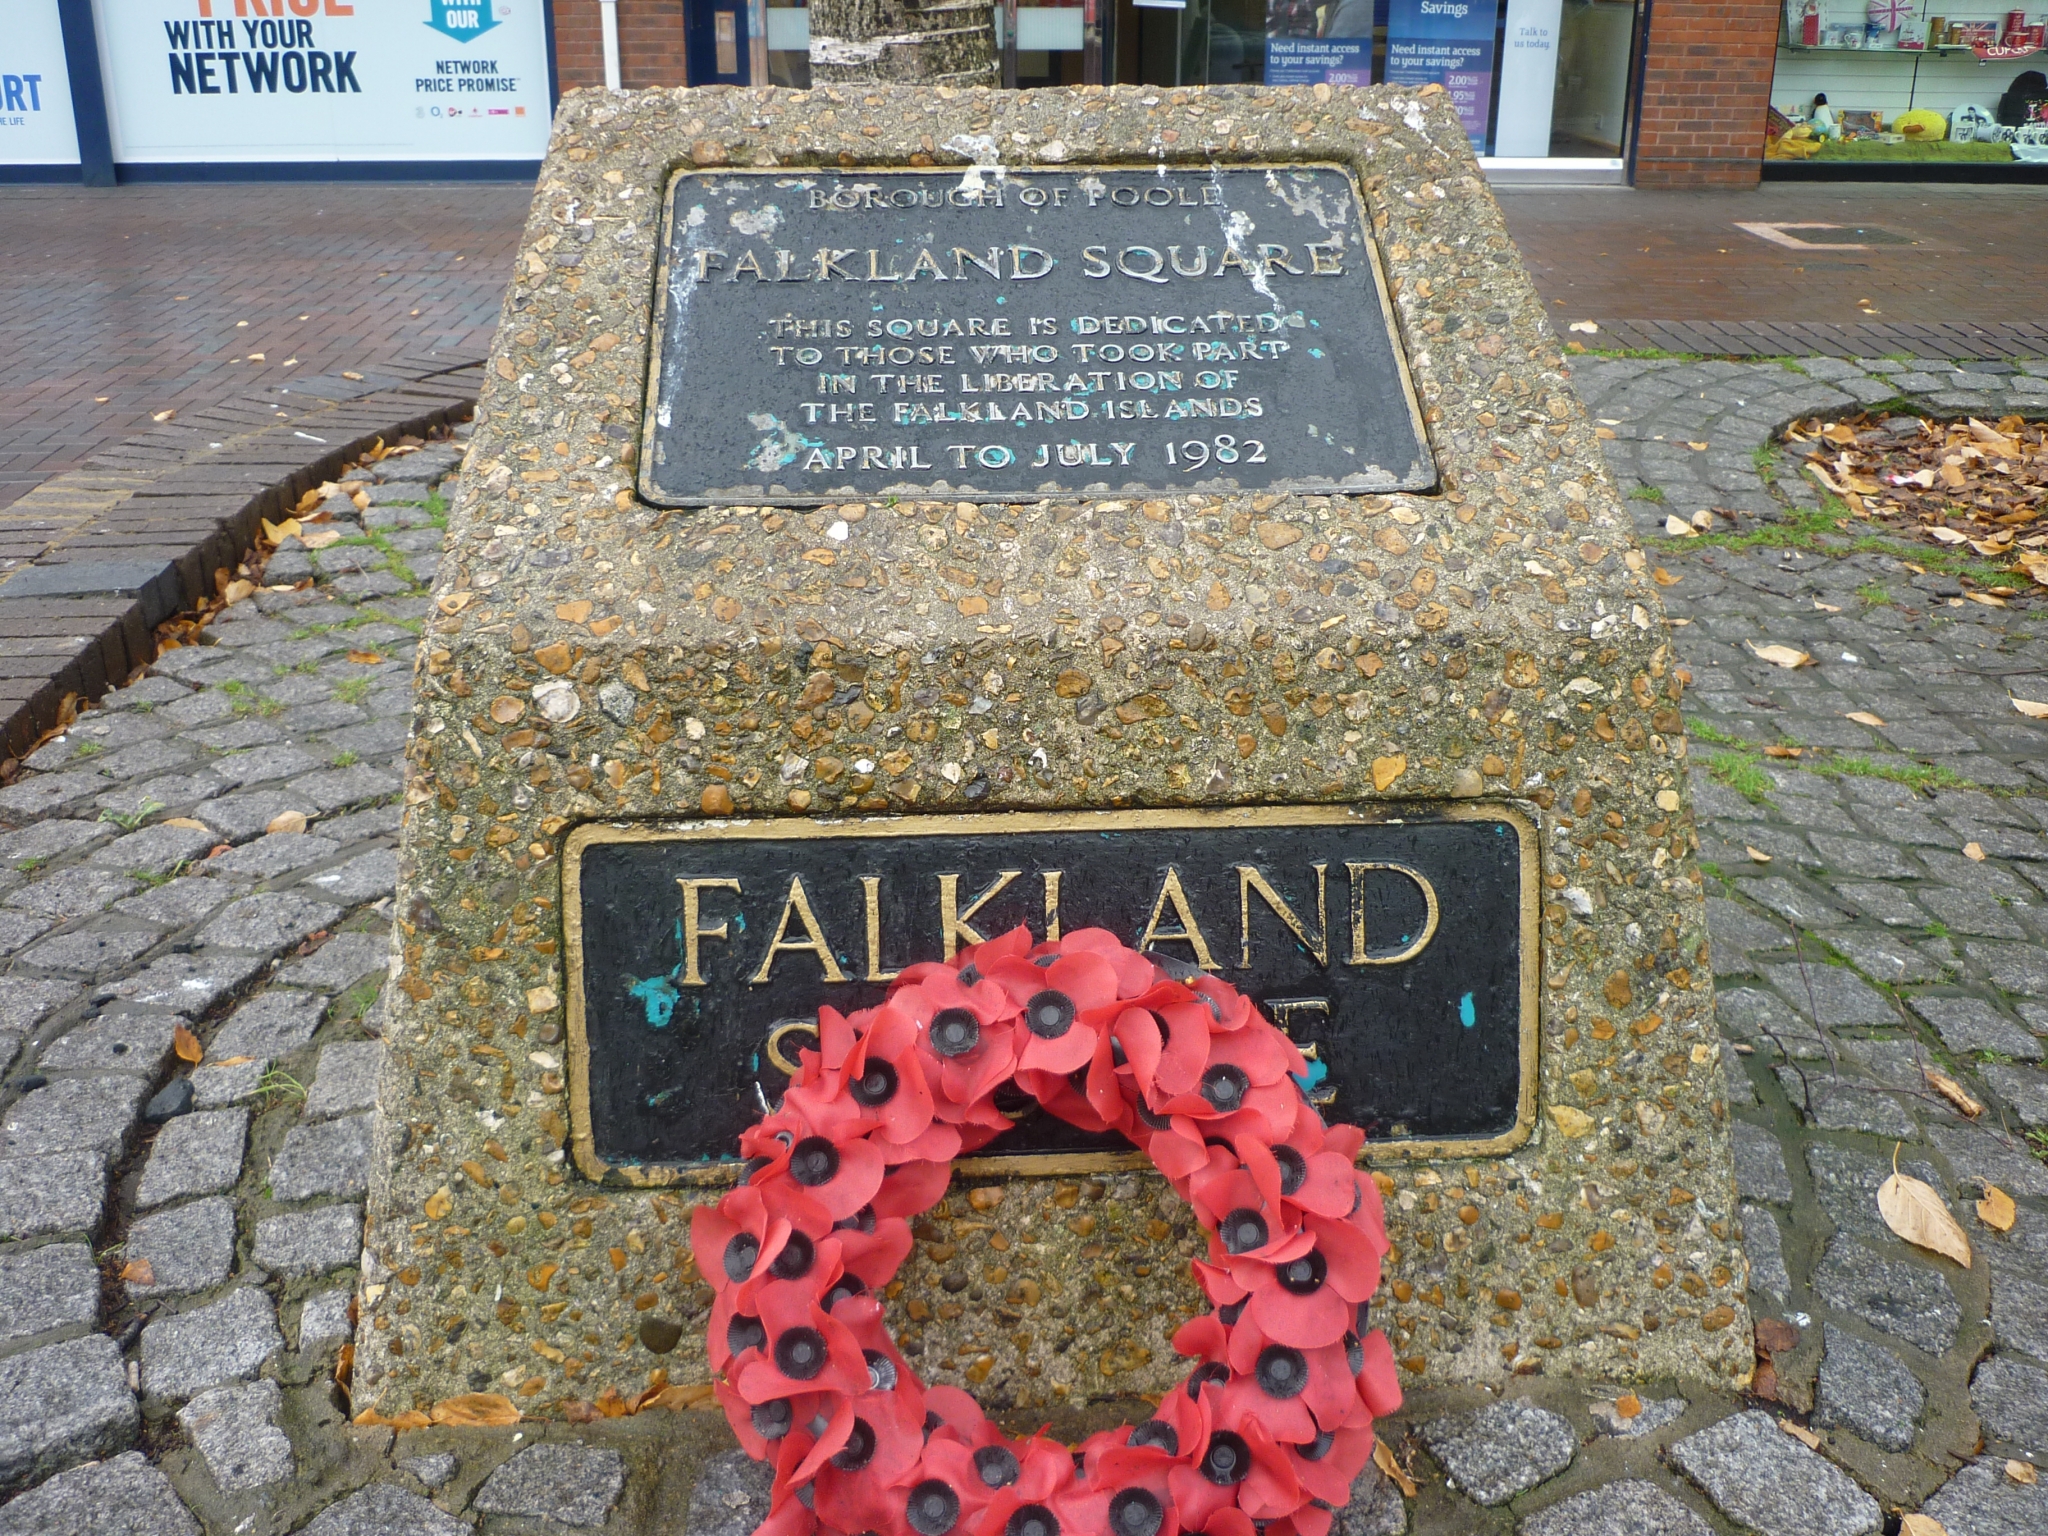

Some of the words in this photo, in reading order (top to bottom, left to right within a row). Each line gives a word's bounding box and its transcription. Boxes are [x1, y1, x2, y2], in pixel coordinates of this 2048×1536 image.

[446, 9, 480, 29] OUR
[1421, 1, 1468, 18] Savings
[164, 20, 236, 50] WITH
[242, 19, 316, 49] YOUR
[1519, 27, 1538, 36] Talk
[1540, 28, 1548, 36] to
[1271, 42, 1296, 54] Need
[1297, 43, 1330, 54] instant
[1331, 45, 1360, 54] access
[1391, 43, 1416, 55] Need
[1417, 45, 1451, 56] instant
[1452, 47, 1481, 57] access
[1514, 40, 1524, 48] us
[436, 60, 499, 74] NETWORK
[1270, 55, 1280, 65] to
[1281, 57, 1304, 67] your
[1305, 55, 1344, 67] savings?
[1390, 56, 1400, 65] to
[1402, 58, 1425, 69] your
[1425, 57, 1464, 70] savings?
[168, 51, 362, 94] NETWORK
[0, 74, 41, 111] RT
[415, 78, 454, 92] PRICE
[9, 117, 25, 126] LIFE
[808, 187, 1004, 210] BOROUGH
[1019, 186, 1070, 208] OF
[1087, 186, 1222, 208] POOLE
[696, 245, 1055, 283] FALKLAND
[1080, 243, 1349, 284] SQUARE
[768, 318, 853, 338] THIS
[867, 317, 1012, 341] SQUARE
[1029, 316, 1058, 335] IS
[1074, 314, 1281, 335] DEDICATED
[769, 345, 824, 366] TO
[835, 345, 957, 365] THOSE
[968, 344, 1059, 364] WHO
[1071, 342, 1183, 363] TOOK
[1192, 340, 1291, 361] PART
[818, 373, 858, 394] IN
[870, 373, 946, 394] THE
[960, 371, 1184, 393] LIBERATION
[1194, 369, 1240, 390] OF
[800, 402, 877, 423] THE
[893, 400, 1091, 423] FALKLAND
[1104, 397, 1264, 420] ISLANDS
[802, 446, 933, 471] APRIL
[946, 445, 1012, 469] TO
[1030, 442, 1137, 468] JULY
[1164, 433, 1269, 473] 1982
[676, 861, 1440, 986] FALKLAND
